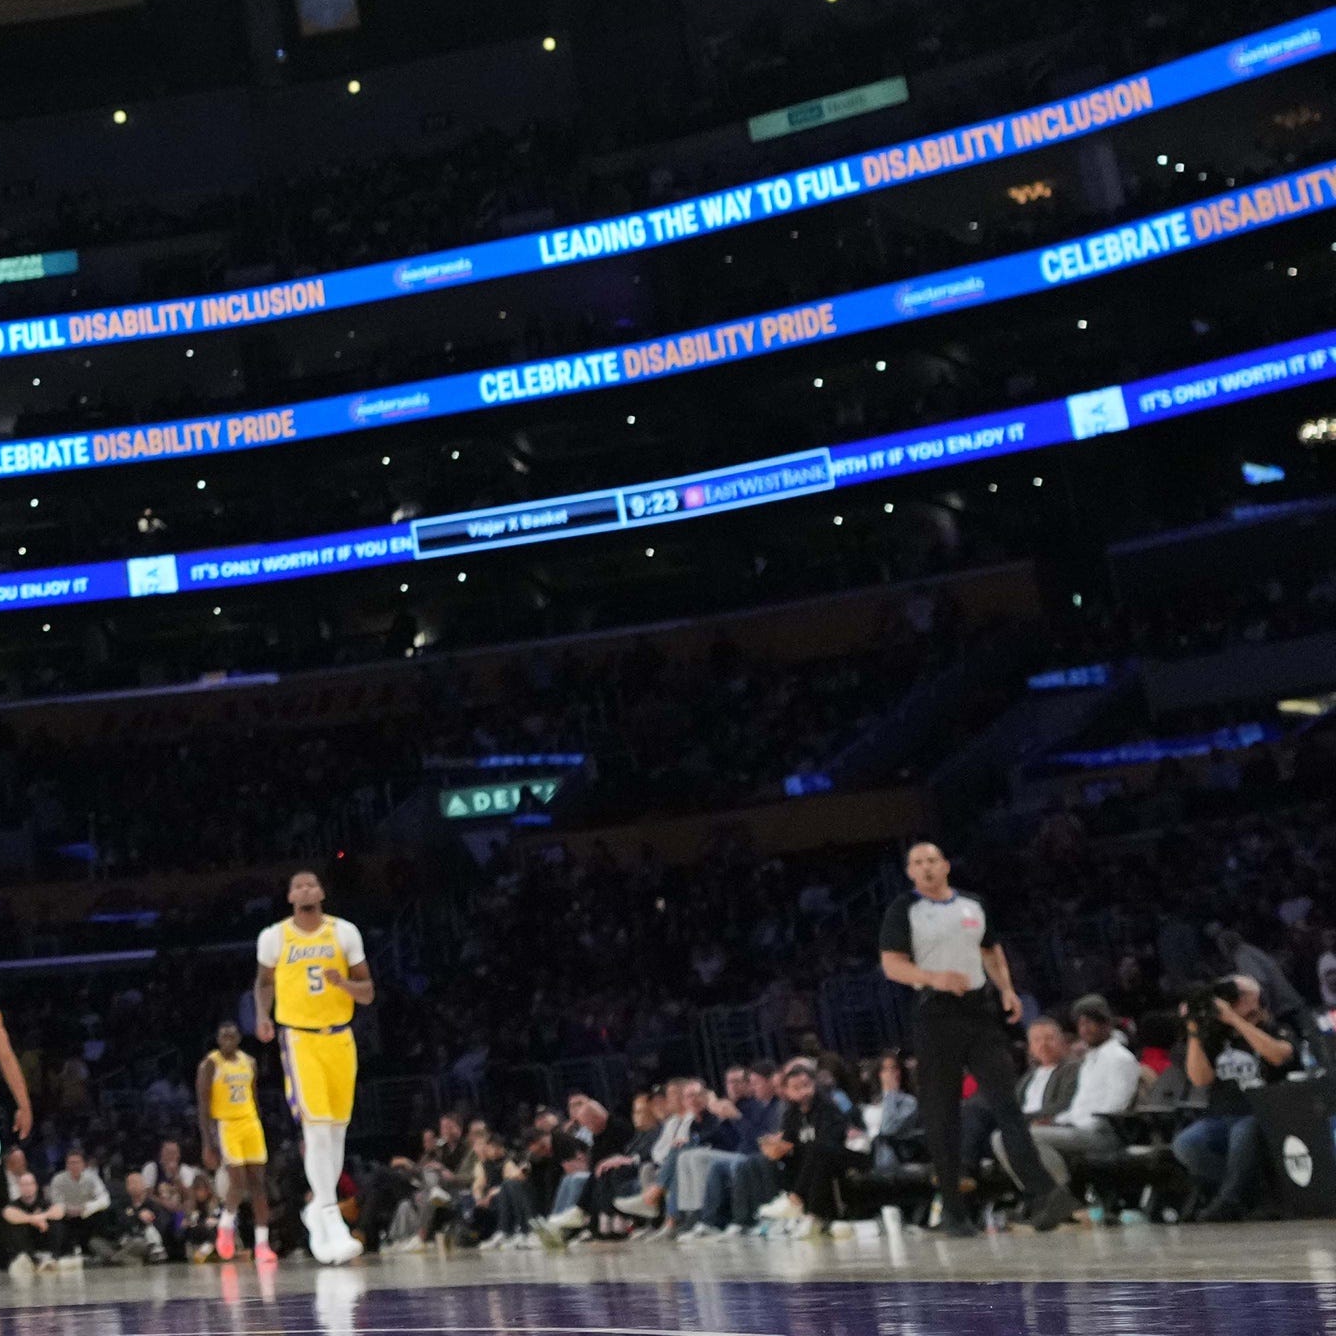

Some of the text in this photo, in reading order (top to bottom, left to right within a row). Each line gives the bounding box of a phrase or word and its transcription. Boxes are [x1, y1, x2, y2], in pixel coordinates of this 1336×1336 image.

[540, 78, 1152, 263] LEADING THE WAY TO FULL DISABILITY INCLUSION
[1042, 168, 1336, 282] CELEBRATE DISABILITY
[9, 320, 65, 350] FULL
[69, 302, 195, 343] DISABILITY
[202, 280, 325, 325] INCLUSION
[481, 304, 836, 402] CELEBRATE DISABILITY PRIDE
[1174, 378, 1217, 403] ONLY
[1220, 361, 1287, 391] WORTH
[1289, 355, 1305, 374] IT
[1309, 350, 1326, 369] IF
[93, 422, 220, 461] DISABILITY
[227, 410, 296, 445] PRIDE
[870, 423, 1025, 469] IT IF YOU ENJOY IT
[631, 490, 679, 517] 9:23
[221, 559, 260, 577] ONLY
[262, 551, 318, 571] WORTH
[321, 548, 334, 563] IT
[337, 545, 350, 560] IF
[355, 540, 387, 557] YOU
[20, 579, 71, 599] ENJOY
[73, 577, 88, 592] IT
[306, 966, 324, 995] 5
